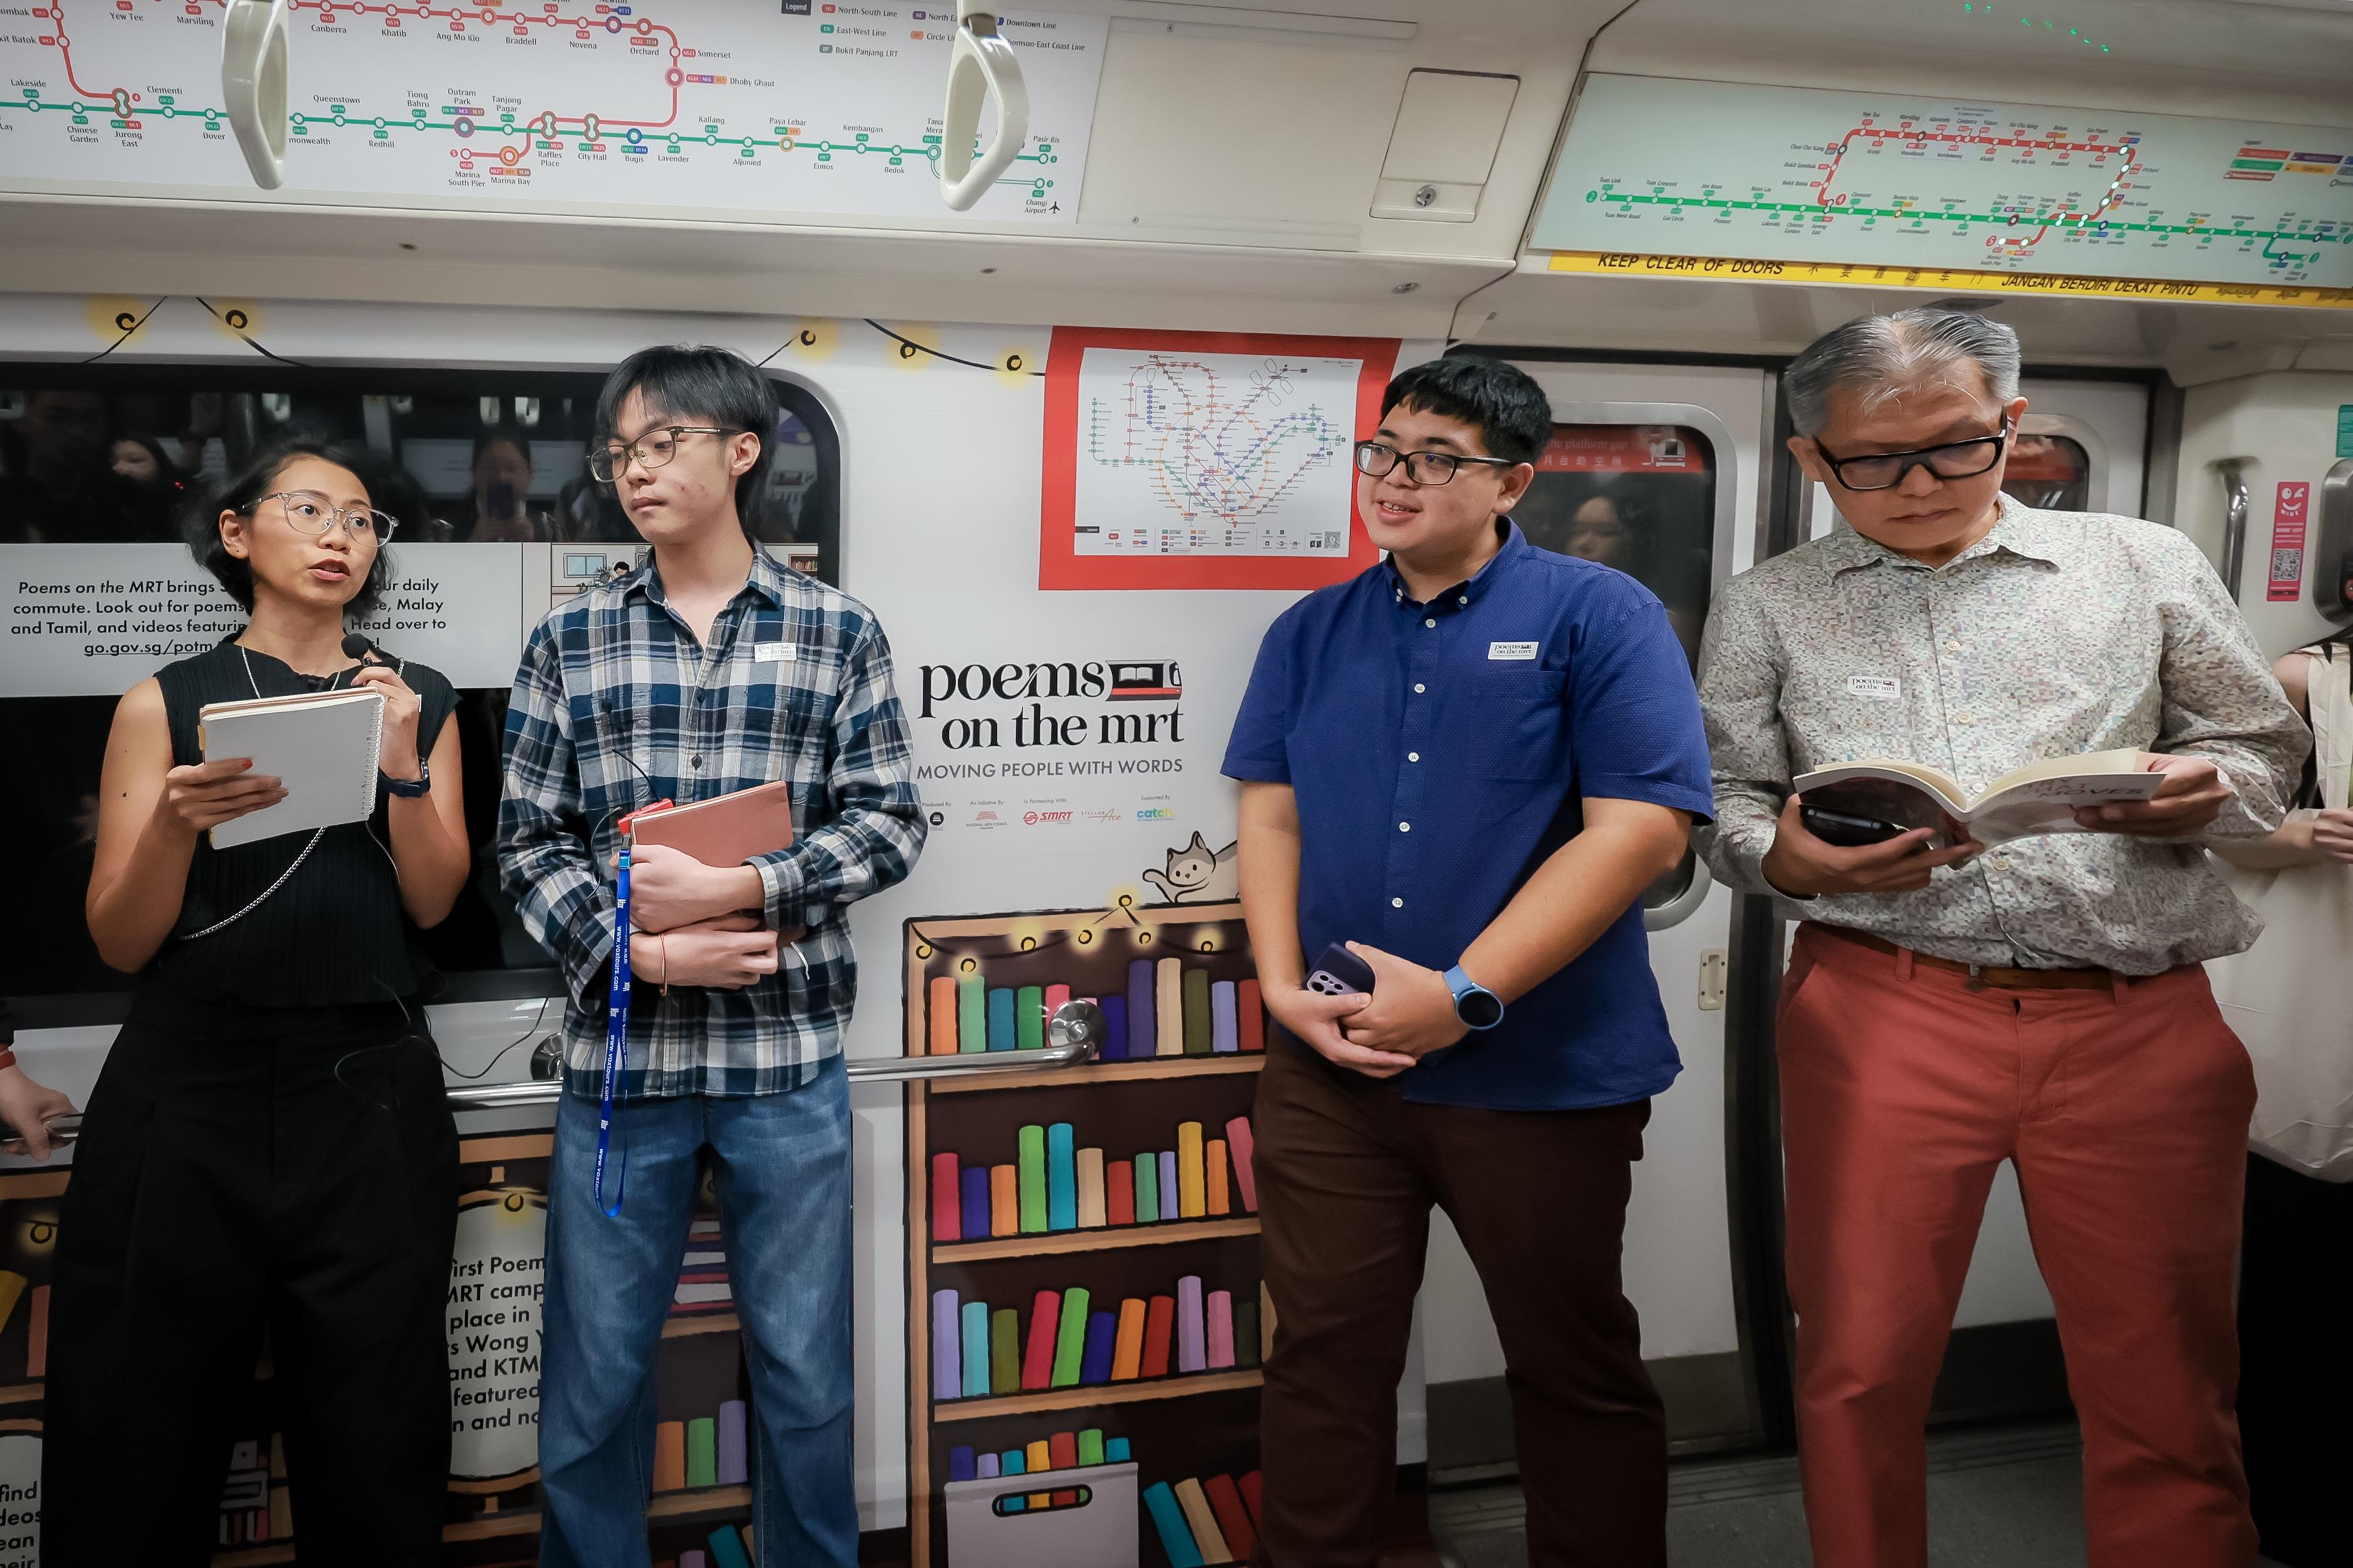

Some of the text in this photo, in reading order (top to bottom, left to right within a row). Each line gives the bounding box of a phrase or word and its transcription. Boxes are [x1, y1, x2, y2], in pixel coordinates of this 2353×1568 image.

[785, 3, 807, 12] Legend
[838, 7, 881, 17] North-South
[177, 16, 214, 27] Marsiling
[928, 13, 948, 21] North
[1006, 19, 1041, 29] Downtown
[311, 25, 346, 34] Canberra
[382, 29, 406, 37] Khatib
[837, 27, 871, 35] East-West
[12, 35, 36, 44] Batok
[436, 32, 451, 42] Ang
[468, 34, 480, 42] Kio
[506, 37, 537, 45] Braddell
[1008, 39, 1050, 49] homson-East
[1052, 42, 1070, 50] Coast
[698, 50, 731, 58] Somerset
[855, 48, 883, 58] Panjang
[730, 78, 751, 86] Dhoby
[147, 86, 183, 94] Clementi
[447, 88, 476, 96] Outram
[313, 94, 360, 103] Queenstown
[407, 91, 428, 99] Tiong
[491, 96, 521, 105] Tanjong
[497, 105, 517, 113] Pagar
[699, 116, 725, 124] Kallang
[842, 124, 883, 133] Kembangan
[70, 135, 98, 144] Garden
[114, 131, 142, 140] Jurong
[369, 140, 395, 148] Redhill
[1598, 253, 1785, 275] KEEP CLEAR OF DOORS
[2002, 275, 2200, 296] JANGAN BERDIRI DEKAT PINTU
[19, 582, 71, 595] Poems
[76, 584, 95, 594] on
[100, 581, 124, 594] the
[129, 581, 163, 593] MRT
[167, 580, 214, 597] brings
[403, 578, 439, 594] daily
[13, 599, 244, 616] commute. Look out for poems
[396, 598, 443, 613] Malay
[11, 622, 41, 634] and
[46, 621, 92, 636] Tamil,
[98, 621, 127, 633] and
[132, 620, 183, 632] videos
[352, 617, 446, 630] Head over to
[918, 662, 1104, 719] poems
[941, 702, 1184, 749] on the mrt
[916, 758, 1182, 779] MOVING PEOPLE WITH WORDS
[1040, 812, 1073, 821] SMRT
[450, 1306, 529, 1334] place in
[465, 1335, 528, 1353] Wong
[450, 1356, 538, 1381] and KTM
[471, 1408, 510, 1430] and
